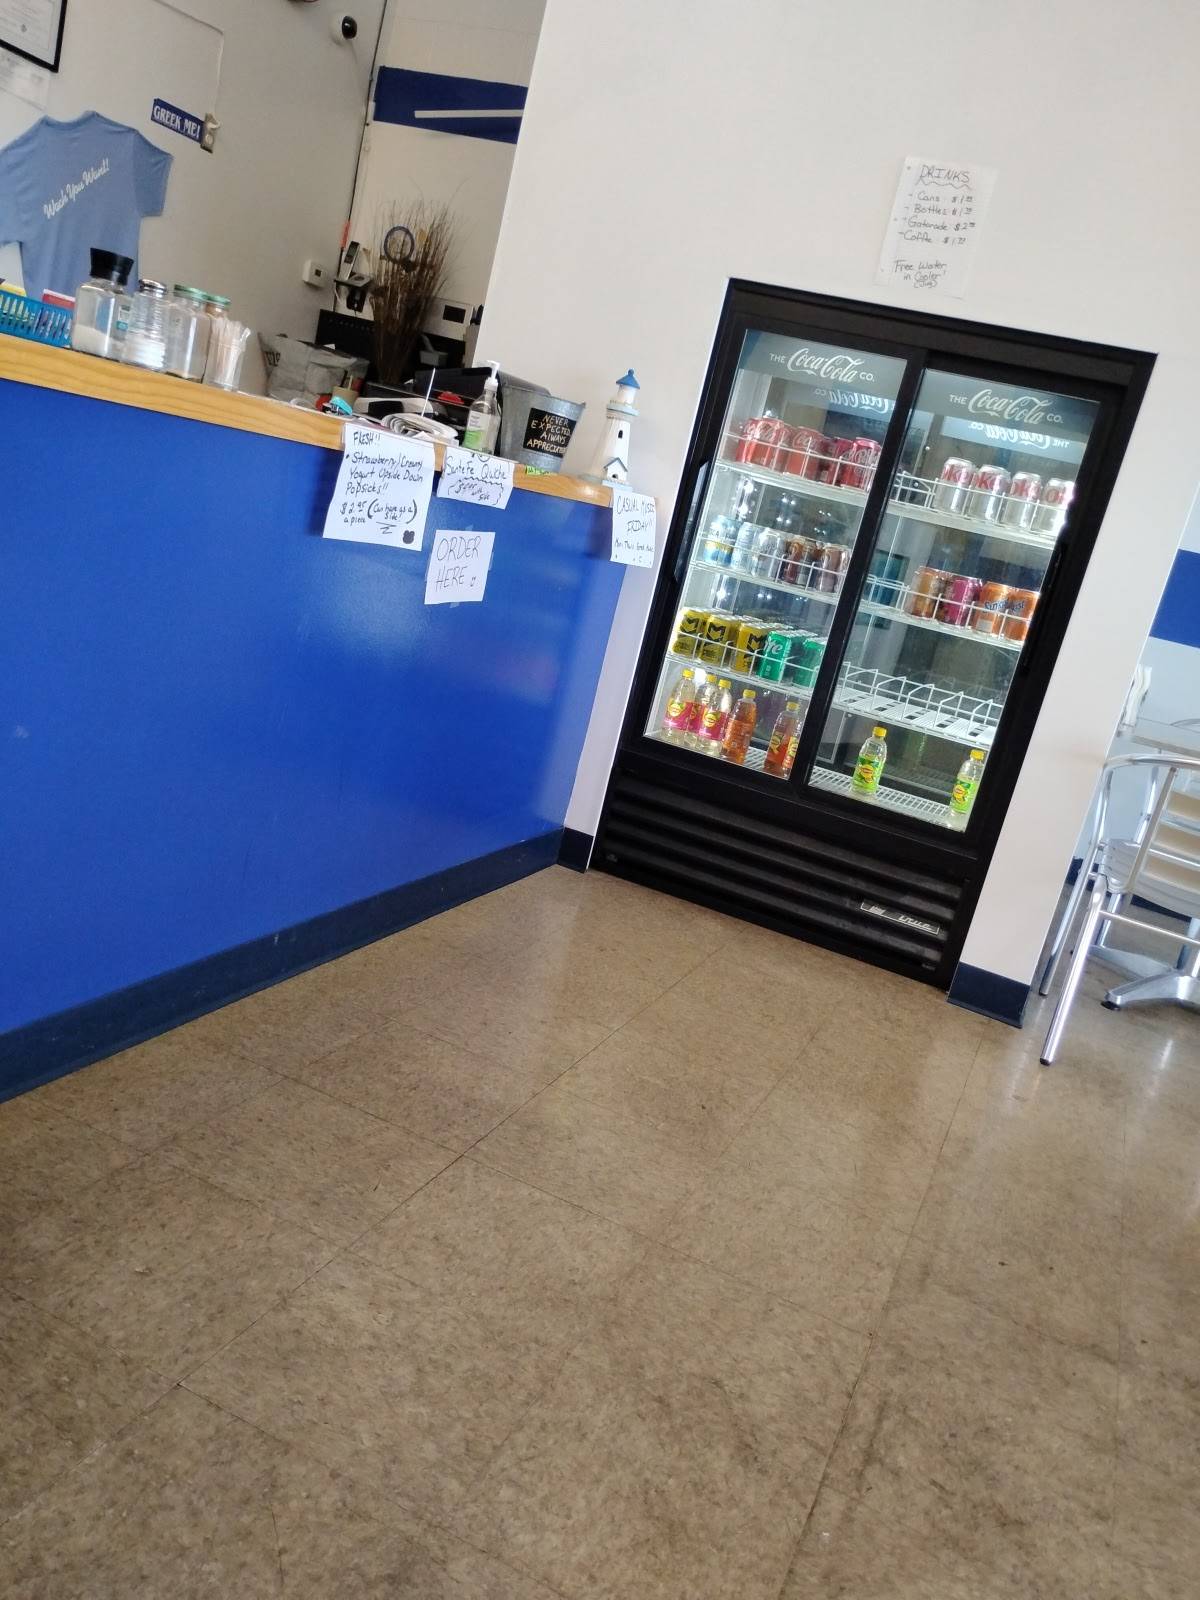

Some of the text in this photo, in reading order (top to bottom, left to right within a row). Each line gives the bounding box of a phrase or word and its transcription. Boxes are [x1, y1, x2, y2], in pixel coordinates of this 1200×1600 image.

[153, 105, 201, 139] GREEK ME!
[920, 164, 970, 183] DRINKS
[917, 190, 940, 202] Cans
[914, 203, 948, 216] Bottles
[907, 214, 949, 231] Gatorade
[893, 259, 948, 273] Free Water
[769, 347, 876, 383] THE Coca-Cola CO.
[949, 388, 1064, 425] THE Coca-Cola CO.
[531, 420, 571, 436] EXPECTED
[543, 414, 569, 427] NEVER
[350, 466, 375, 481] Yogurt
[403, 469, 423, 483] Down
[436, 535, 482, 561] ORDER
[435, 565, 469, 592] HERE
